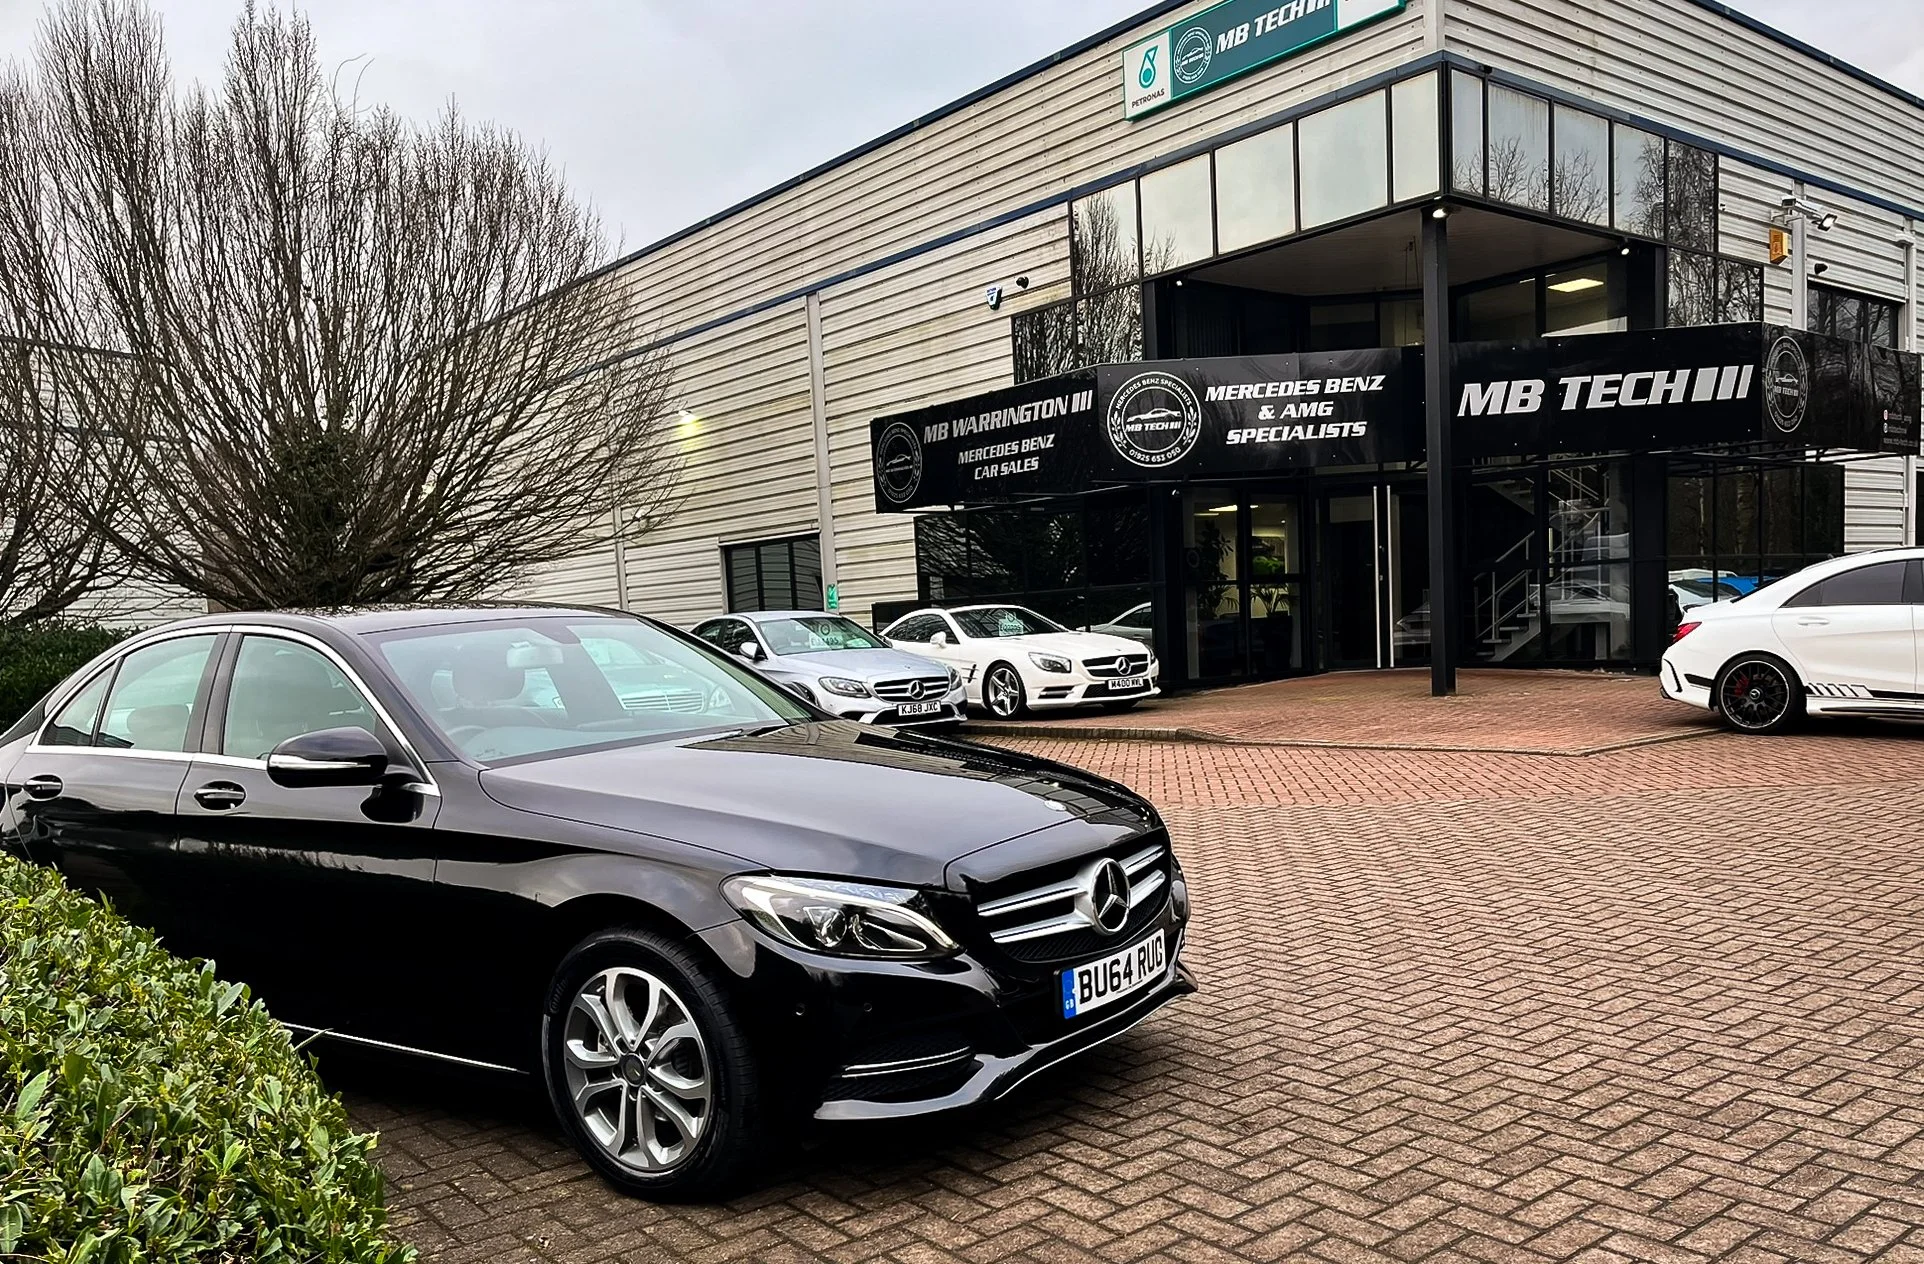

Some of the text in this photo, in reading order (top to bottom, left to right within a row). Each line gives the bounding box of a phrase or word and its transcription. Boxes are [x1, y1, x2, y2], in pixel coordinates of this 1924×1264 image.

[1216, 23, 1250, 55] MB
[1131, 88, 1166, 109] PETRONAS
[1115, 378, 1192, 409] MERCEDES BENZ SPECIALISTS
[1204, 375, 1387, 402] MERCEDES BENZ
[1457, 379, 1546, 417] MB
[924, 421, 950, 444] MB
[952, 395, 1069, 438] WARRINGTON
[1257, 401, 1334, 421] & AMG
[1126, 423, 1142, 432] MB
[1225, 421, 1368, 445] SPECIALISTS
[958, 434, 1055, 465] MERCEDES BENZ
[1128, 449, 1150, 462] 01925
[1166, 446, 1181, 459] 050
[974, 457, 1039, 480] CAR SALES
[901, 702, 938, 714] KJ68 JXC
[1078, 953, 1133, 1004] BU64
